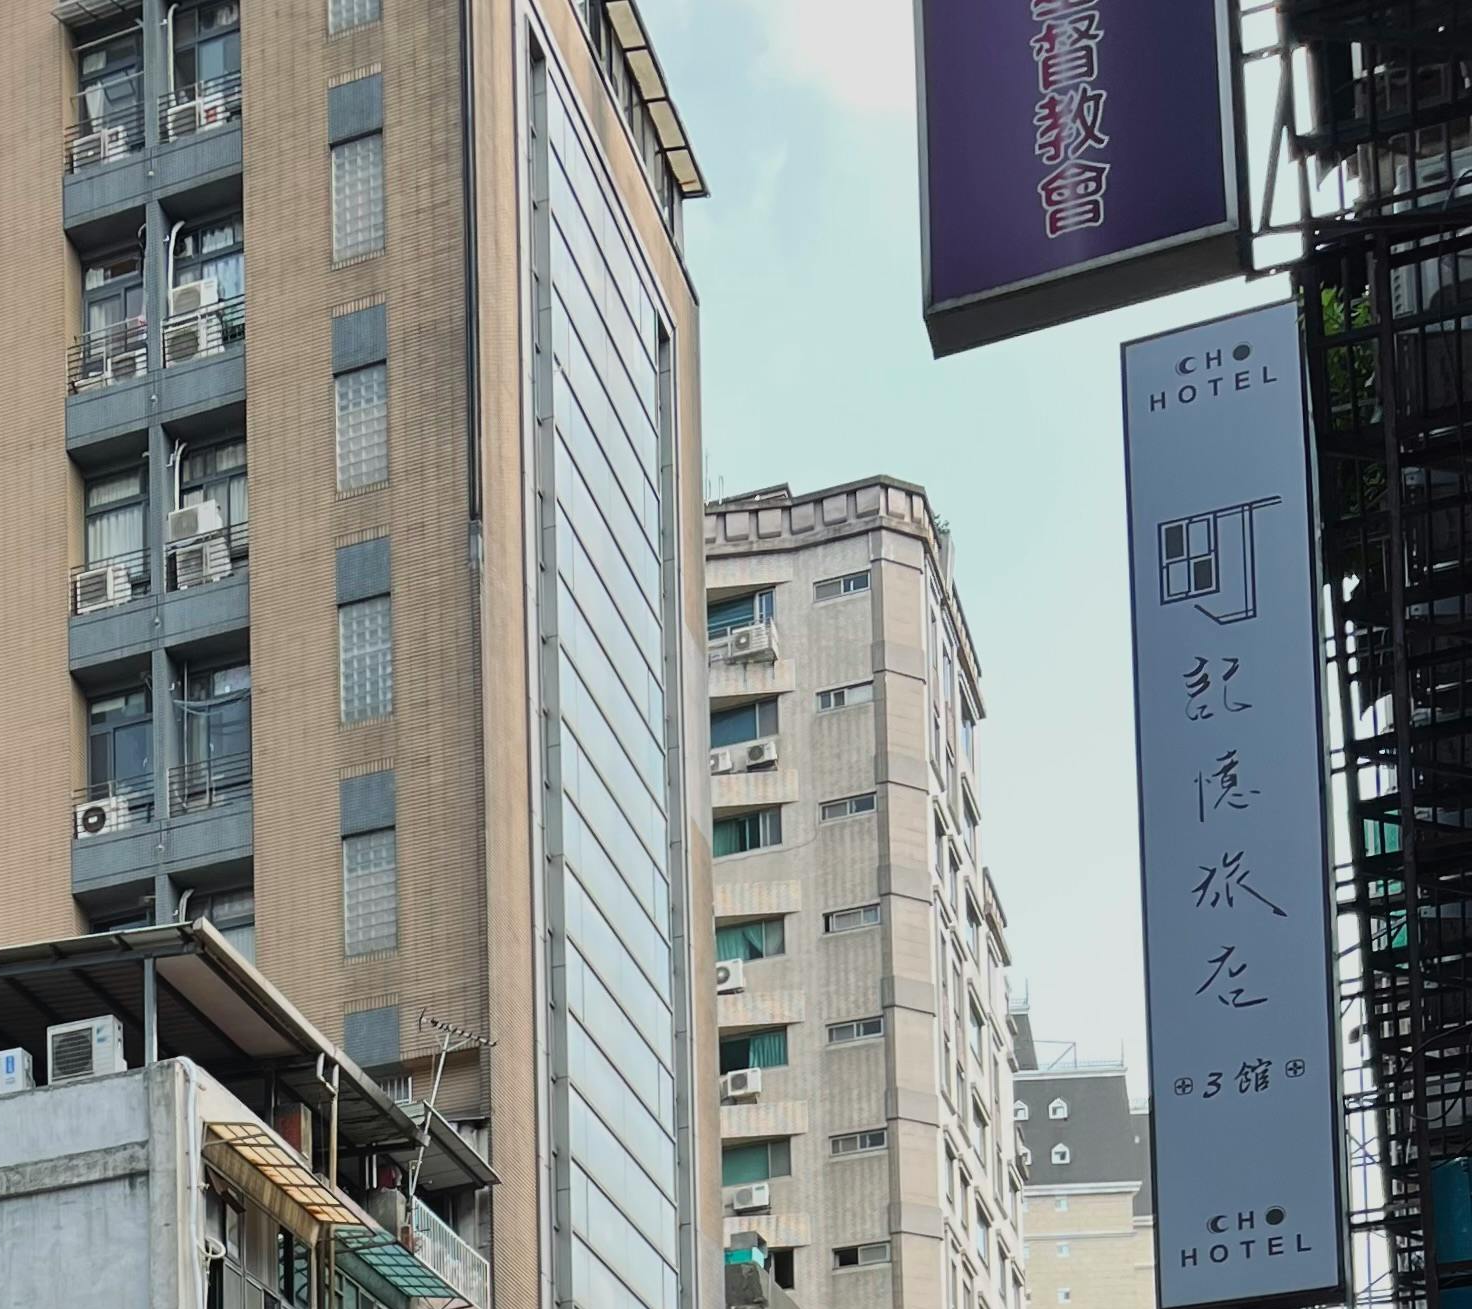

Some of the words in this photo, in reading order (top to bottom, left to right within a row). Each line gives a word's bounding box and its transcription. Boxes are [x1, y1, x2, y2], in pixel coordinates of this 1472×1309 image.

[1031, 0, 1109, 238] 督教會
[1150, 365, 1277, 412] HOTEL
[1182, 1233, 1311, 1268] HOTEL
